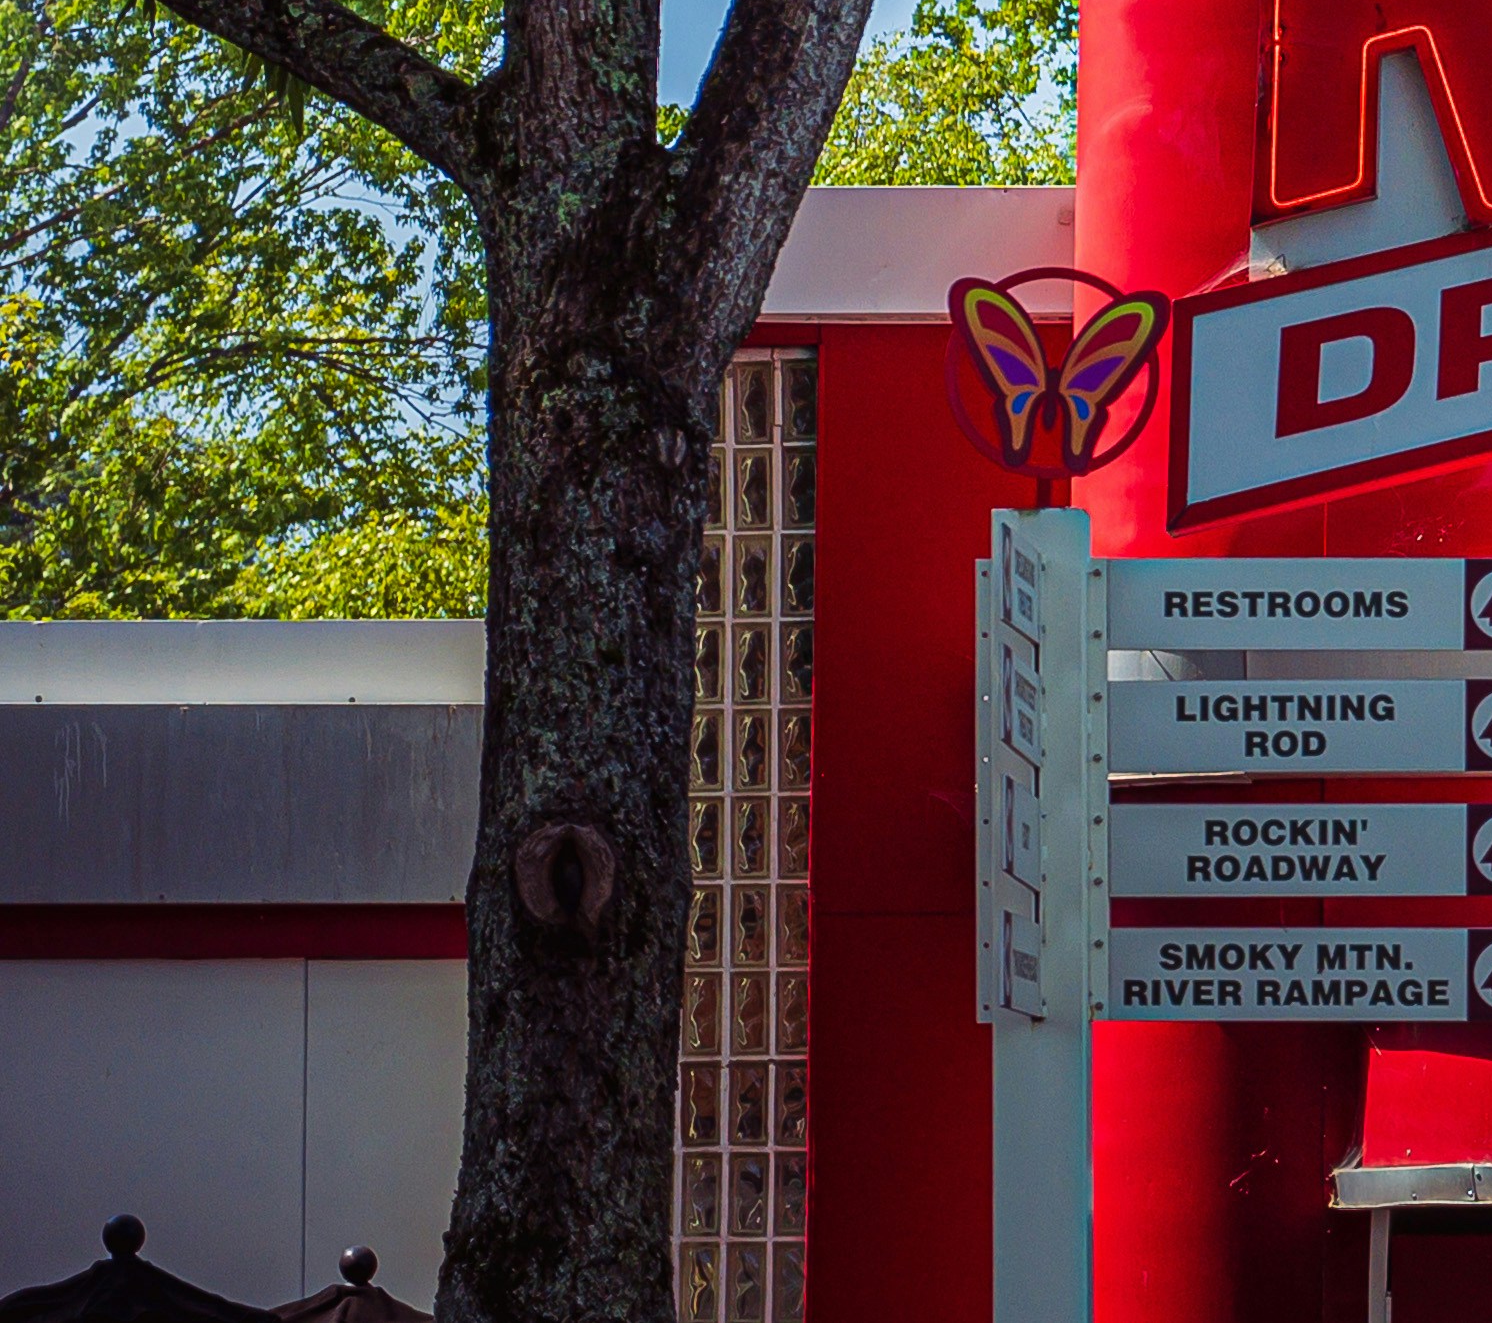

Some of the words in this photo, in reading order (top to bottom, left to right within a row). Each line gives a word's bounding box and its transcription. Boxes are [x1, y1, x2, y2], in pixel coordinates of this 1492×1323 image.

[1163, 590, 1410, 618] RESTROOMS
[1175, 694, 1396, 722] LIGHTNING
[1244, 730, 1328, 758] ROD
[1204, 818, 1369, 847] ROCKIN'
[1186, 854, 1387, 882] ROADWAY
[1158, 942, 1304, 971] SMOKY
[1316, 943, 1414, 972] MTN.
[1122, 979, 1243, 1007] RIVER
[1255, 978, 1450, 1007] RAMPAGE
